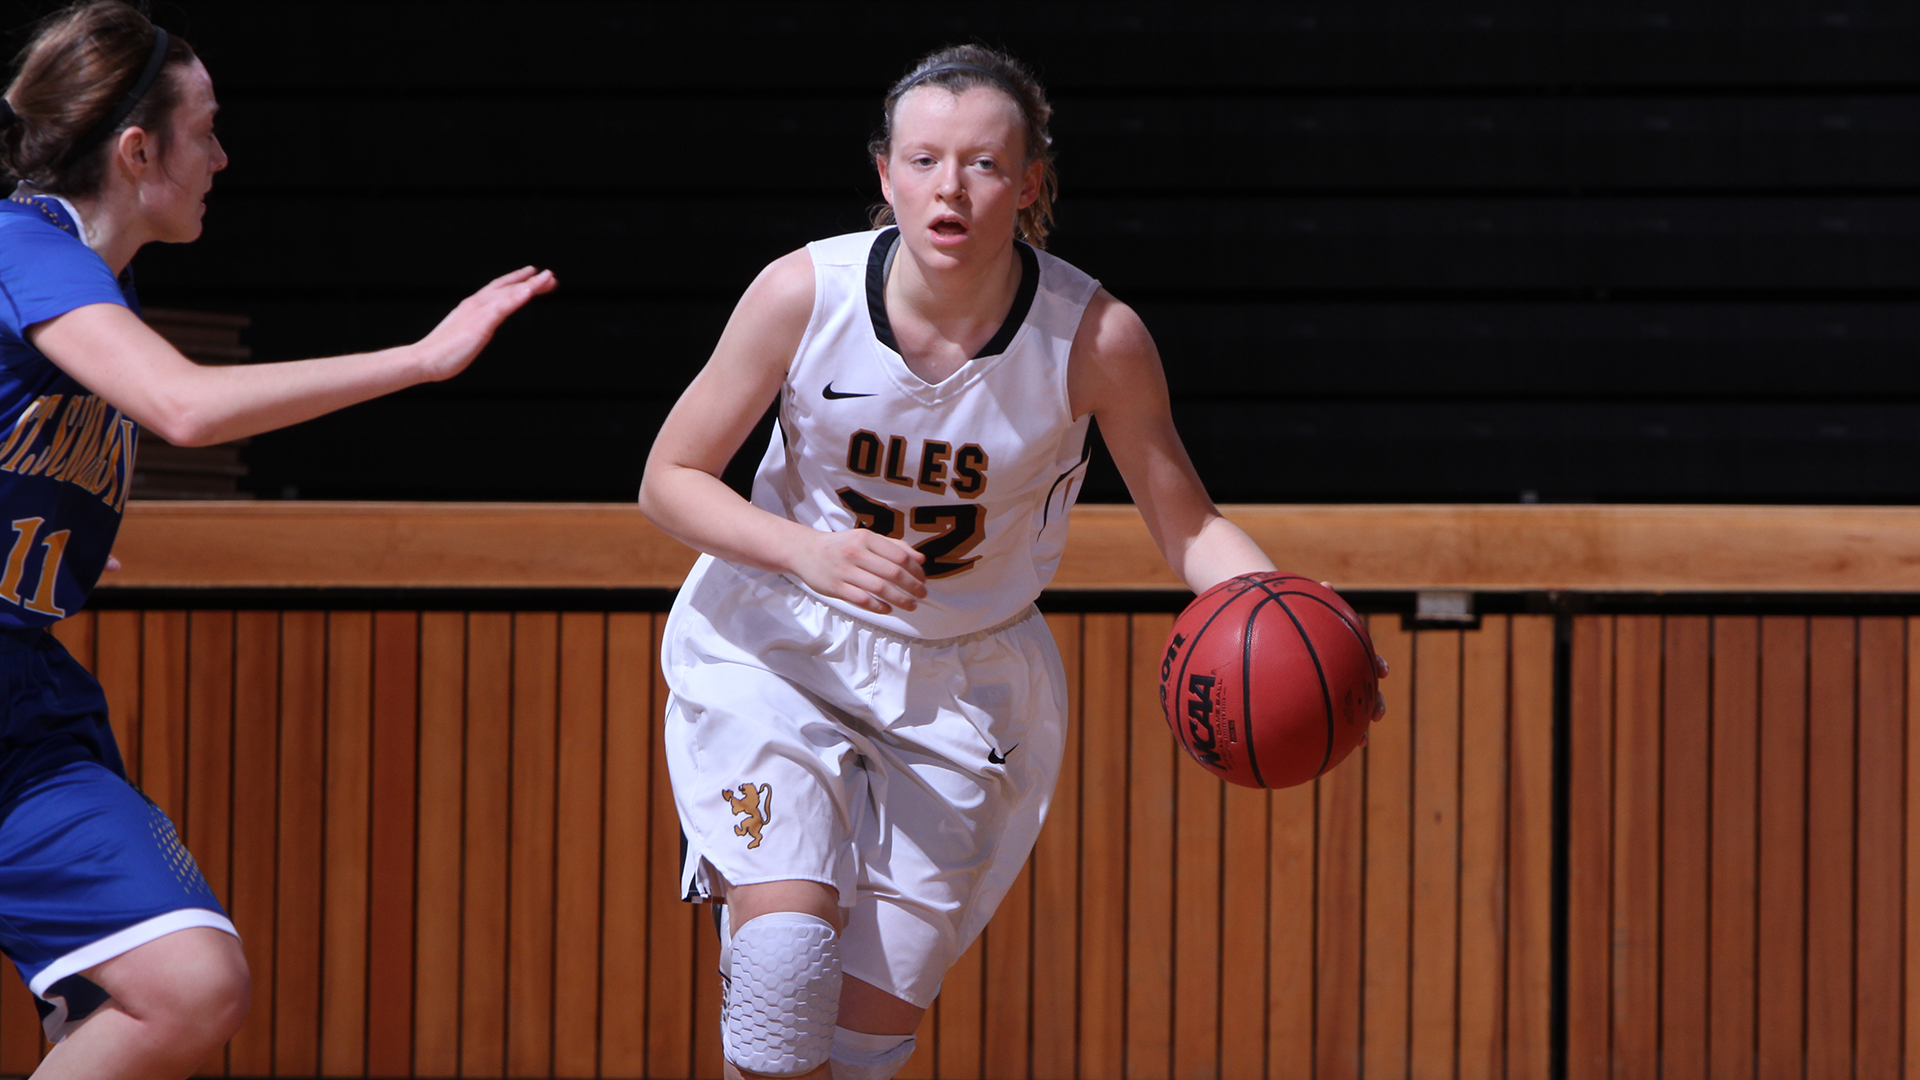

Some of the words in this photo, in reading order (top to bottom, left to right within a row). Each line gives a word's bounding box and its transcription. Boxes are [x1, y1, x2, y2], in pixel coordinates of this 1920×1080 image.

[846, 428, 989, 500] OLES
[0, 516, 71, 619] 11
[1188, 673, 1228, 771] NCAA
